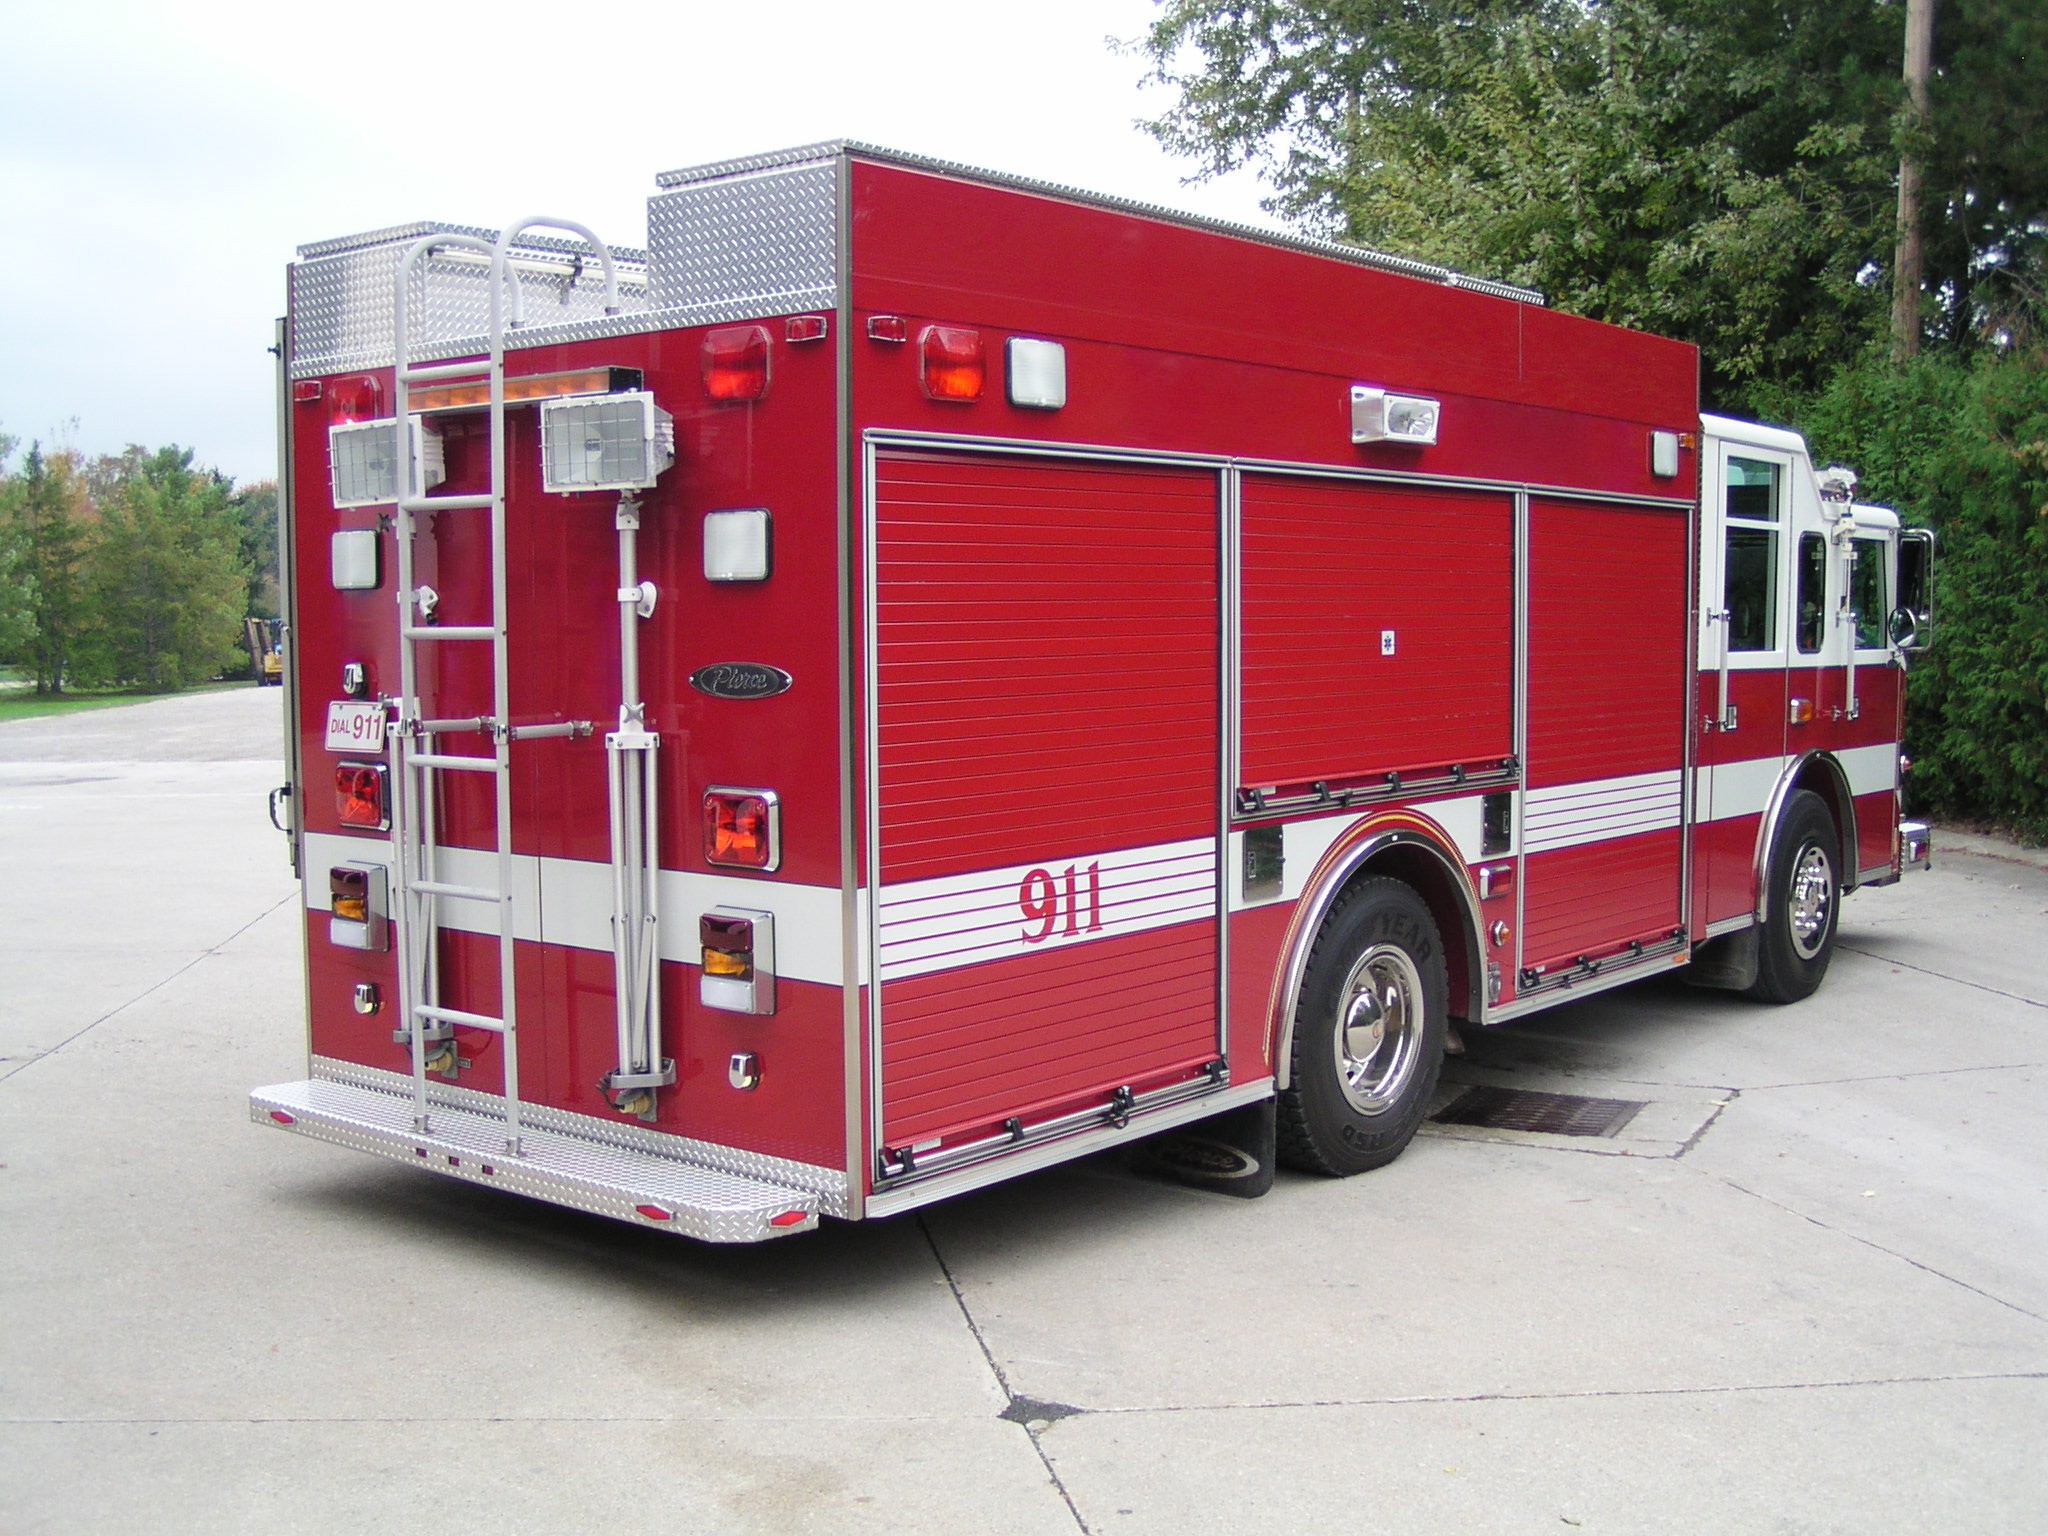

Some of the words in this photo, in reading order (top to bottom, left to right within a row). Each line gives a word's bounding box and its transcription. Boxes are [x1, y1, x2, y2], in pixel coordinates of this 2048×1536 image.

[713, 666, 768, 692] Pierce
[331, 719, 351, 734] DIAL
[353, 714, 382, 740] 911
[1019, 860, 1104, 945] 911
